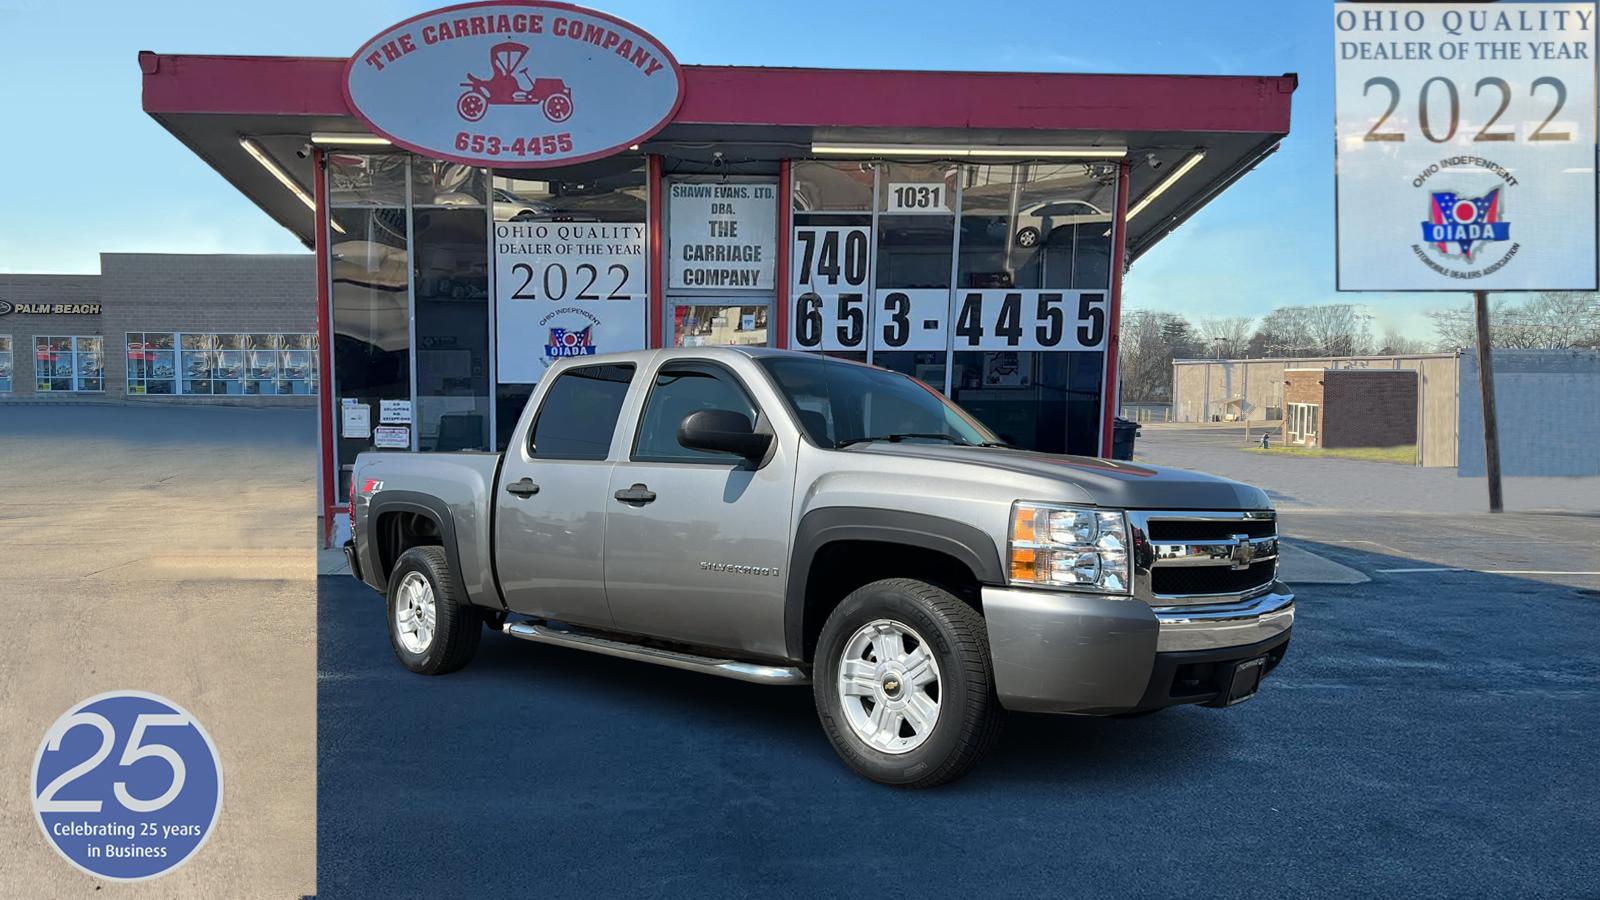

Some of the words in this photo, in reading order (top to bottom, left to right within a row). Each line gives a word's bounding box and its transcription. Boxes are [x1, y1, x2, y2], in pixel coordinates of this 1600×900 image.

[1336, 9, 1425, 32] OHIO
[1442, 9, 1593, 36] QUALITY
[366, 33, 417, 71] THE
[422, 14, 544, 45] CARRIAGE
[552, 17, 664, 77] COMPANY
[1340, 41, 1433, 61] DEALER
[1439, 41, 1470, 60] OF
[1474, 41, 1522, 60] THE
[1528, 41, 1589, 60] YEAR
[1362, 76, 1571, 143] 2022
[454, 132, 573, 157] 653-4455
[1412, 164, 1440, 189] OHIO
[1440, 155, 1519, 188] INDEPENDENT
[672, 185, 712, 198] SHAWN
[894, 186, 941, 209] 1031
[711, 203, 736, 215] DBA.
[497, 225, 548, 239] OHIO
[557, 225, 644, 241] QUALITY
[708, 220, 738, 238] THE
[1432, 223, 1496, 242] OIADA
[499, 243, 552, 256] DEALER
[555, 244, 573, 255] OF
[576, 244, 603, 255] THE
[606, 244, 642, 255] YEAR
[683, 244, 762, 262] CARRIAGE
[796, 229, 869, 286] 740
[1410, 243, 1450, 278] AUTOMOBILE
[1450, 268, 1482, 280] DEALERS
[1482, 242, 1521, 277] ASSOCIATION
[510, 262, 632, 301] 2022
[683, 268, 760, 286] COMPANY
[14, 303, 51, 314] PALM
[54, 303, 101, 315] BEACH
[539, 312, 556, 327] OHIO
[555, 306, 601, 327] INDEPENDENT
[795, 292, 1105, 348] 653-4455
[551, 346, 588, 356] OIADA
[700, 561, 769, 577] SILVERADO
